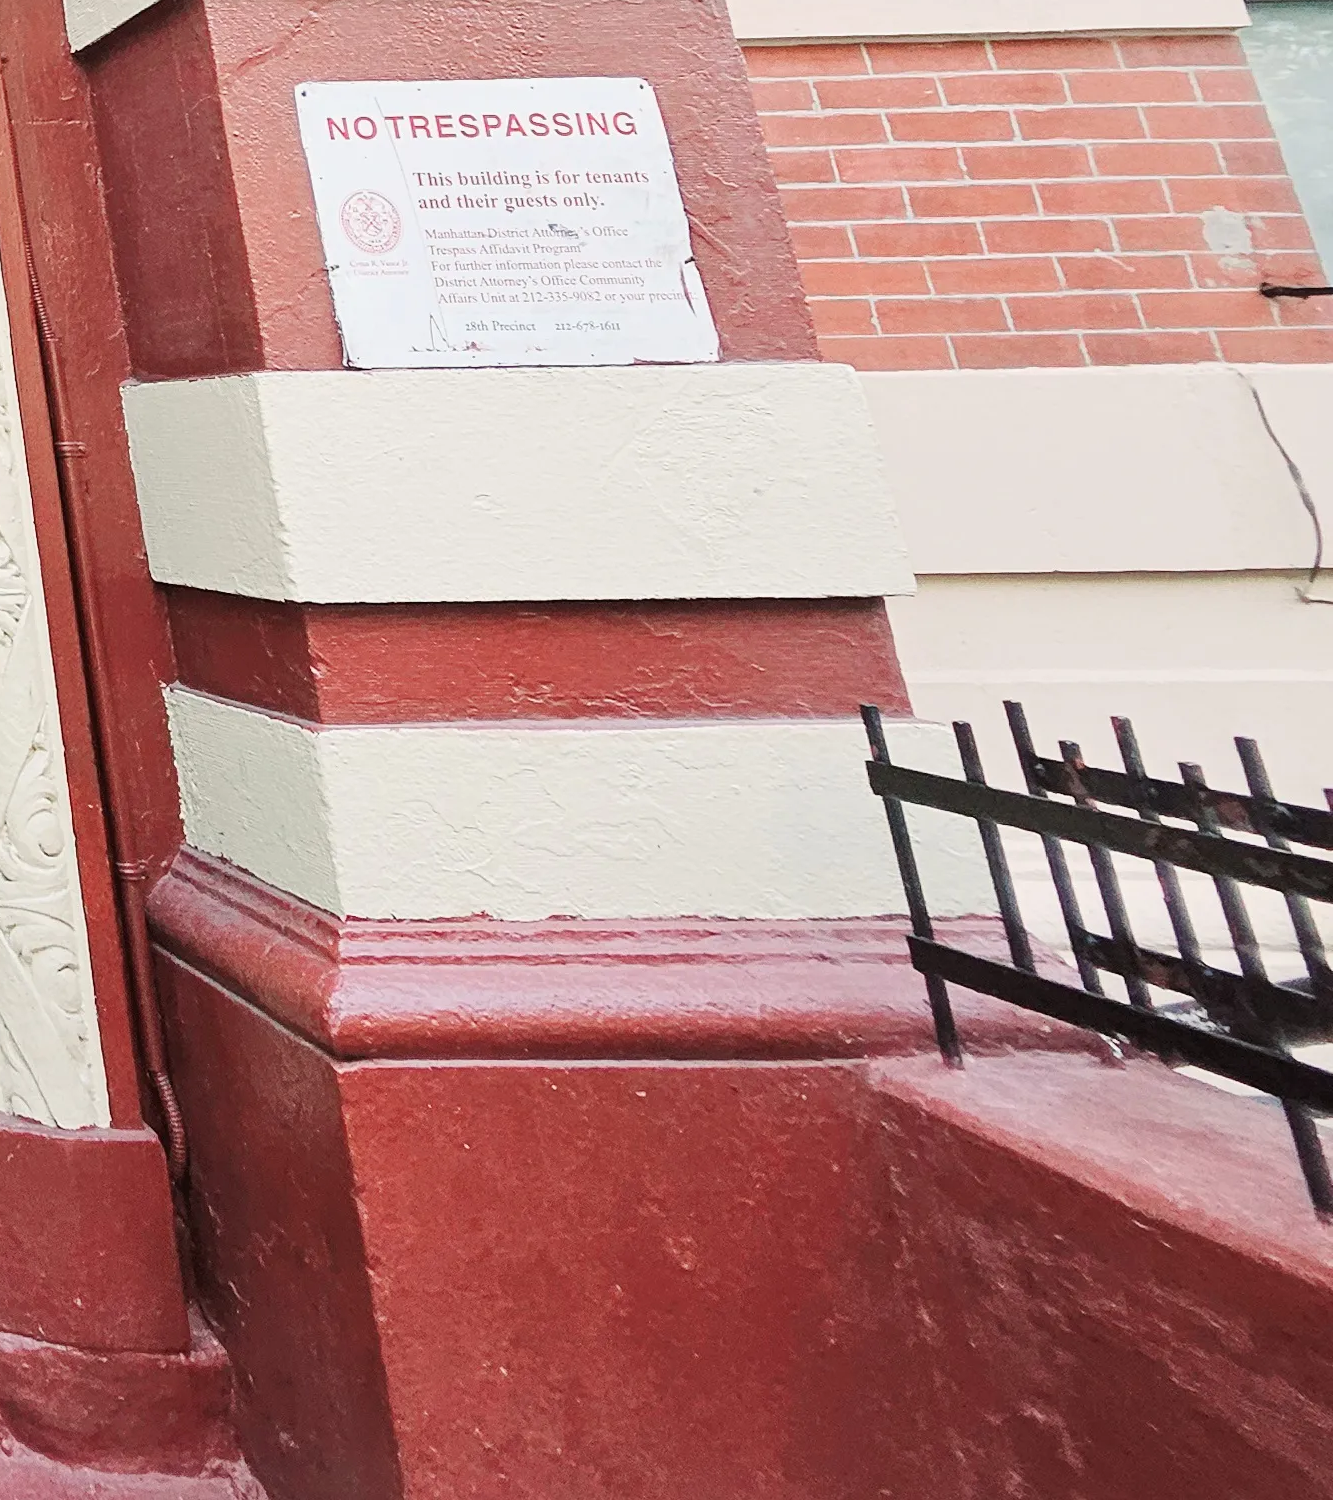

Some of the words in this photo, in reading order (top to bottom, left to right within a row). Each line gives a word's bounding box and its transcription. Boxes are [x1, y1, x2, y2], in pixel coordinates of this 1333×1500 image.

[326, 116, 378, 140] NO
[384, 112, 638, 139] TRESPASSING
[412, 172, 453, 187] This
[457, 171, 533, 189] building
[535, 170, 550, 184] is
[554, 170, 581, 185] for
[585, 170, 650, 184] tenants
[418, 194, 452, 209] and
[457, 193, 498, 209] their
[504, 194, 558, 213] guests
[563, 192, 605, 210] only.
[425, 229, 485, 240] Manhattan
[486, 228, 530, 239] District
[532, 226, 591, 240] Attorne's
[592, 226, 629, 237] Office
[427, 244, 477, 257] Trespass
[479, 244, 531, 255] Affidavit
[532, 243, 582, 256] Program
[431, 260, 451, 271] For
[454, 260, 492, 271] further
[495, 259, 562, 270] information
[564, 259, 599, 272] please
[601, 259, 642, 269] contact
[645, 258, 663, 268] the
[434, 276, 477, 287] District
[480, 275, 539, 289] Attorney's
[540, 275, 576, 286] Office
[579, 274, 645, 288] Community
[438, 293, 479, 304] Affairs
[480, 292, 507, 303] Unit
[509, 293, 520, 303] at
[521, 290, 602, 302] 212-335-9082
[604, 293, 618, 301] or
[619, 291, 645, 304] your
[648, 289, 699, 304] precint:
[465, 320, 489, 332] 28th
[491, 320, 537, 332] Precinct
[555, 320, 621, 332] 212-678-1611
